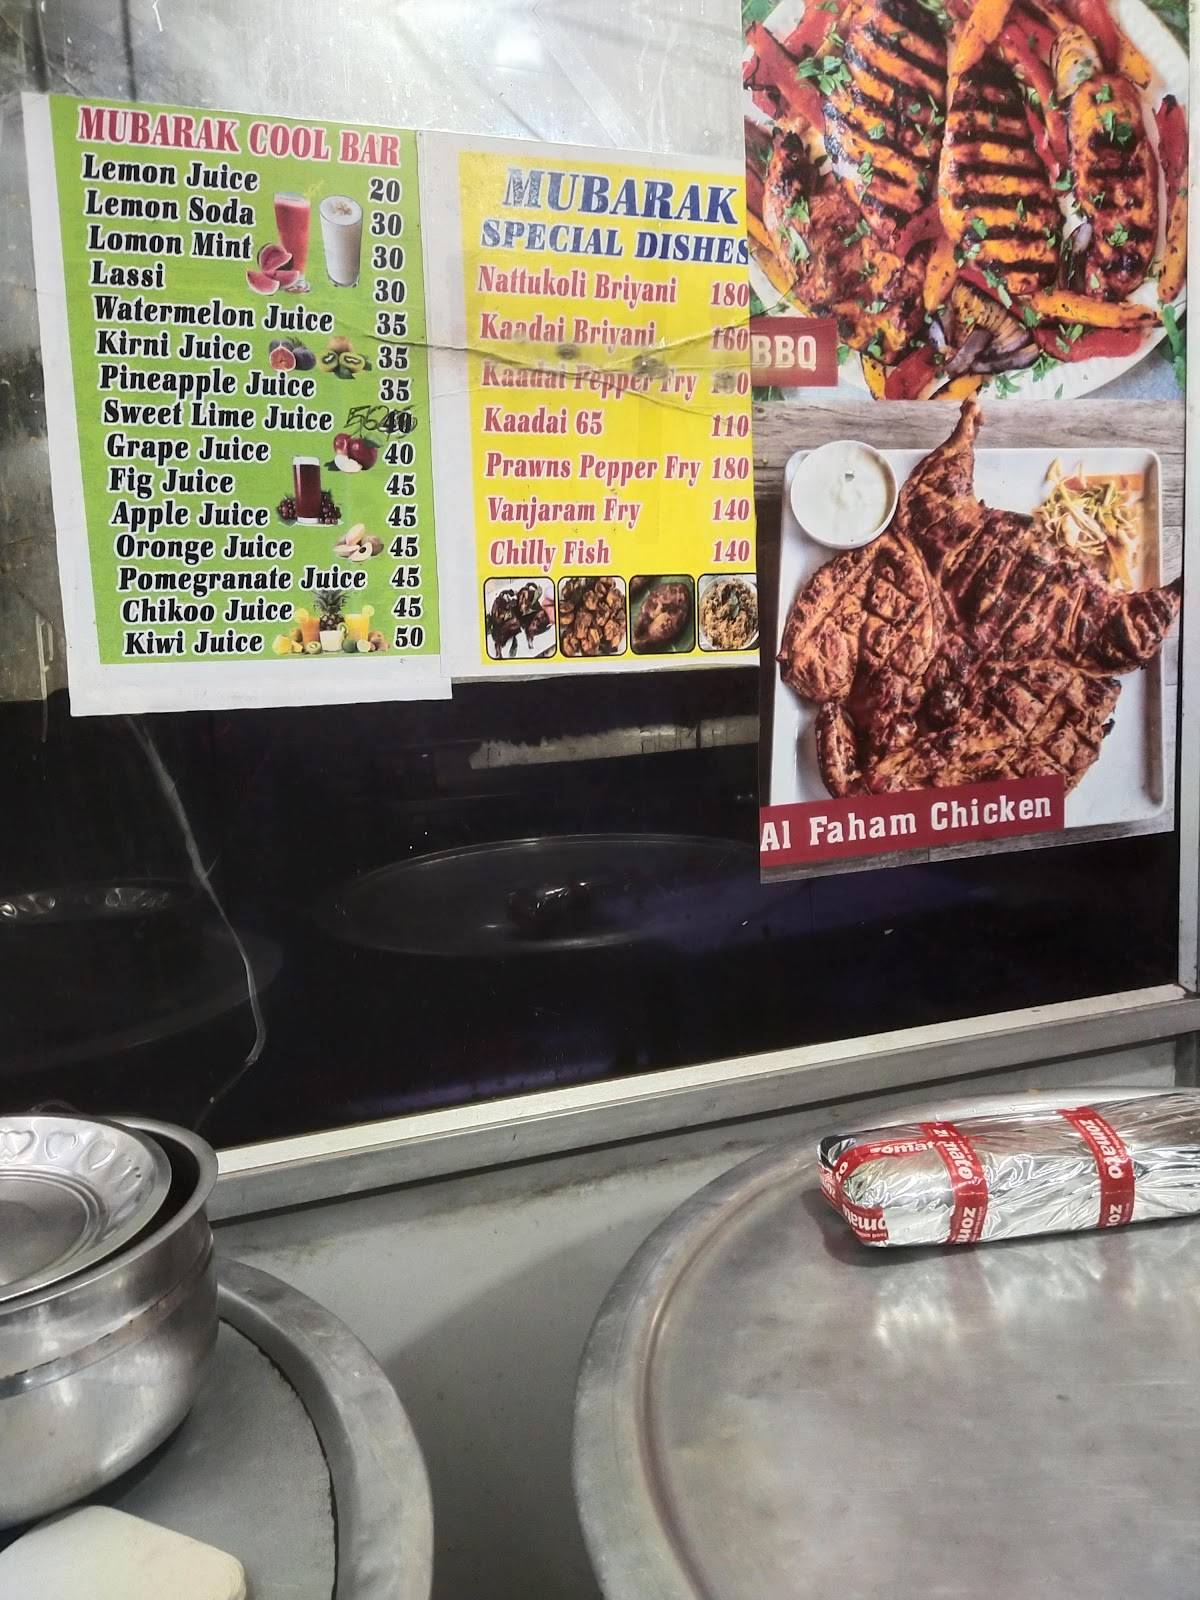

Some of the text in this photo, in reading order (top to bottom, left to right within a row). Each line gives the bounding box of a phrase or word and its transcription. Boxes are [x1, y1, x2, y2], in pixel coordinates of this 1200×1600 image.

[79, 107, 400, 166] MUBARAK COOL BAR
[83, 155, 400, 202] Lemon Juice 20
[503, 169, 738, 225] MUBARAK
[86, 190, 401, 236] Lemon Soda 30
[89, 226, 403, 269] Lomon Mint 30
[480, 219, 749, 265] SPECIAL DISHES
[91, 261, 406, 303] Lassi 30
[478, 266, 749, 310] Nattukoli Briyani 180
[94, 296, 407, 336] Watermelon Juice 35
[480, 313, 564, 343] Kaadai
[574, 318, 656, 352] Briyani
[97, 330, 408, 369] Kirni Juice 35
[751, 335, 817, 372] BBQ
[100, 365, 410, 401] Pineapple Juice 35
[104, 400, 181, 427] Sweet
[192, 403, 253, 428] Lime
[264, 406, 332, 431] Juice
[484, 408, 749, 437] Kaadai 65 110
[107, 433, 414, 465] Grape Juice 40
[109, 468, 416, 498] Fig Juice 45
[486, 452, 749, 486] Prawns Pepper Fry 180
[111, 502, 417, 531] Apple Juice 45
[488, 497, 750, 529] Vanjaram Fry 140
[116, 535, 418, 563] Oronge Juice 45
[490, 539, 750, 572] Chilly Fish 140
[119, 567, 420, 596] Pomegranate Juice 45
[122, 596, 422, 622] Chikoo Juice 45
[125, 627, 423, 655] Kiwi Juice 50
[760, 795, 1051, 852] Al Faham Chicken
[1079, 1119, 1124, 1179] zomato
